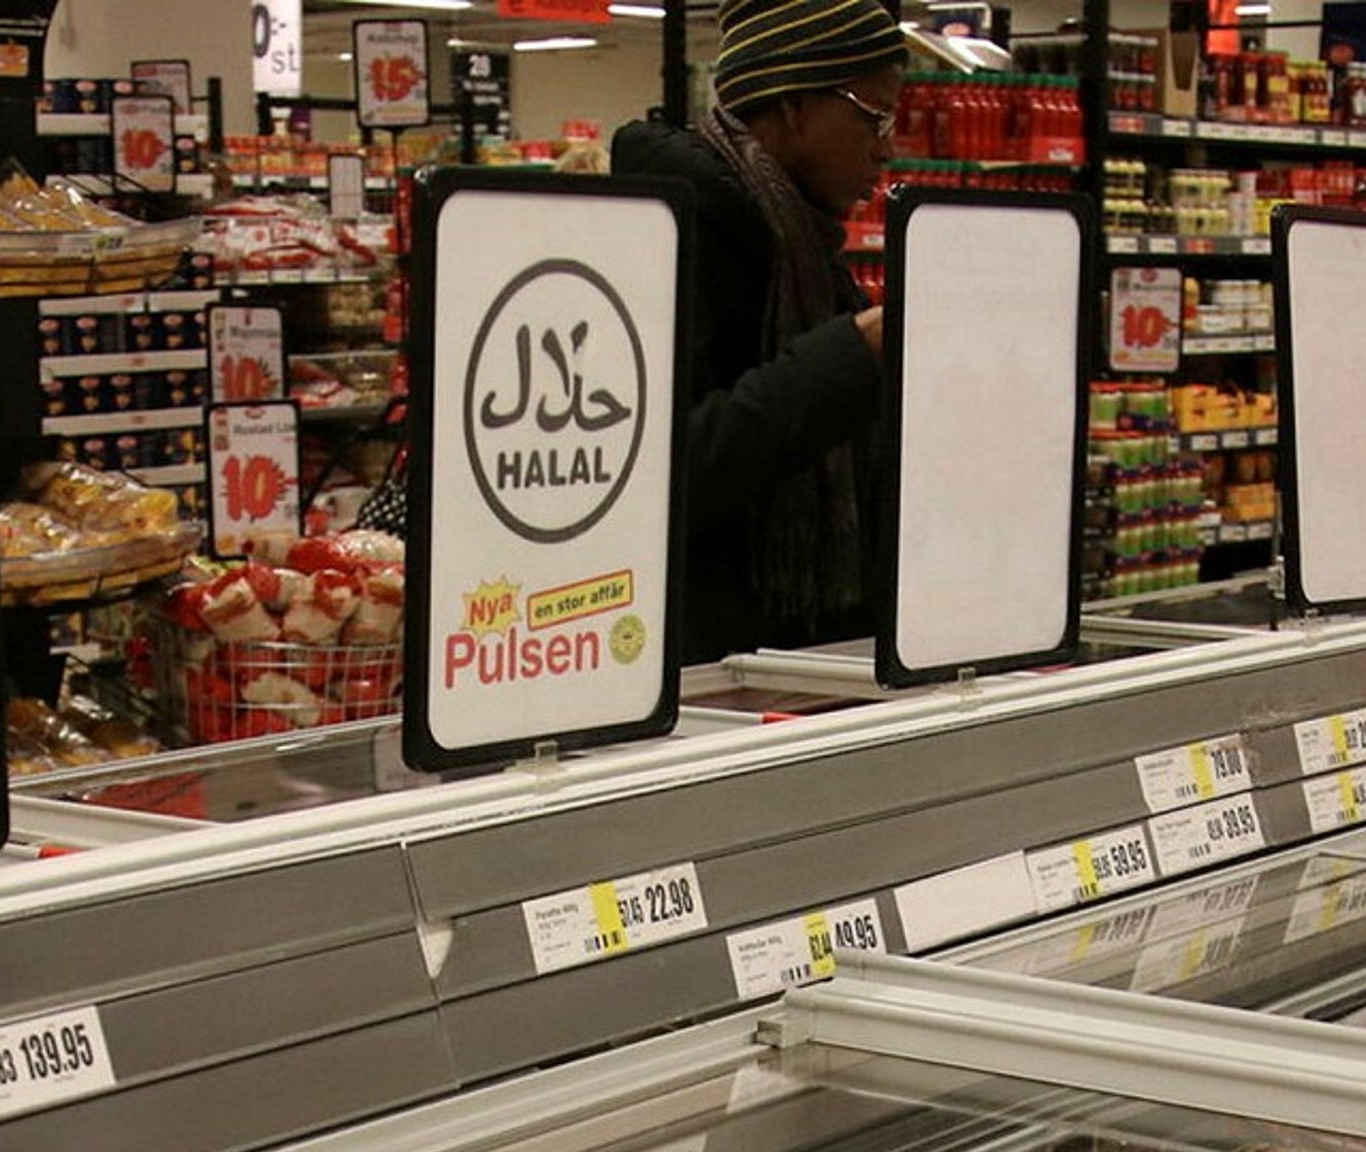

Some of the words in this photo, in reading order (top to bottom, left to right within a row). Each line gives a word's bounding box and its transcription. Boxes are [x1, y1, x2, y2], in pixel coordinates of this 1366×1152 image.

[1122, 305, 1164, 349] 10
[479, 319, 633, 433] حلال
[222, 454, 283, 522] 10
[496, 446, 613, 491] HALAL
[468, 591, 513, 627] Nya
[534, 602, 554, 619] en
[556, 593, 587, 615] stor
[589, 582, 627, 606] affär
[444, 626, 600, 690] Pulsen
[1110, 839, 1149, 878] 59.95
[643, 877, 695, 923] 22.98
[833, 914, 877, 950] 49.95
[18, 1023, 95, 1081] 139.95
